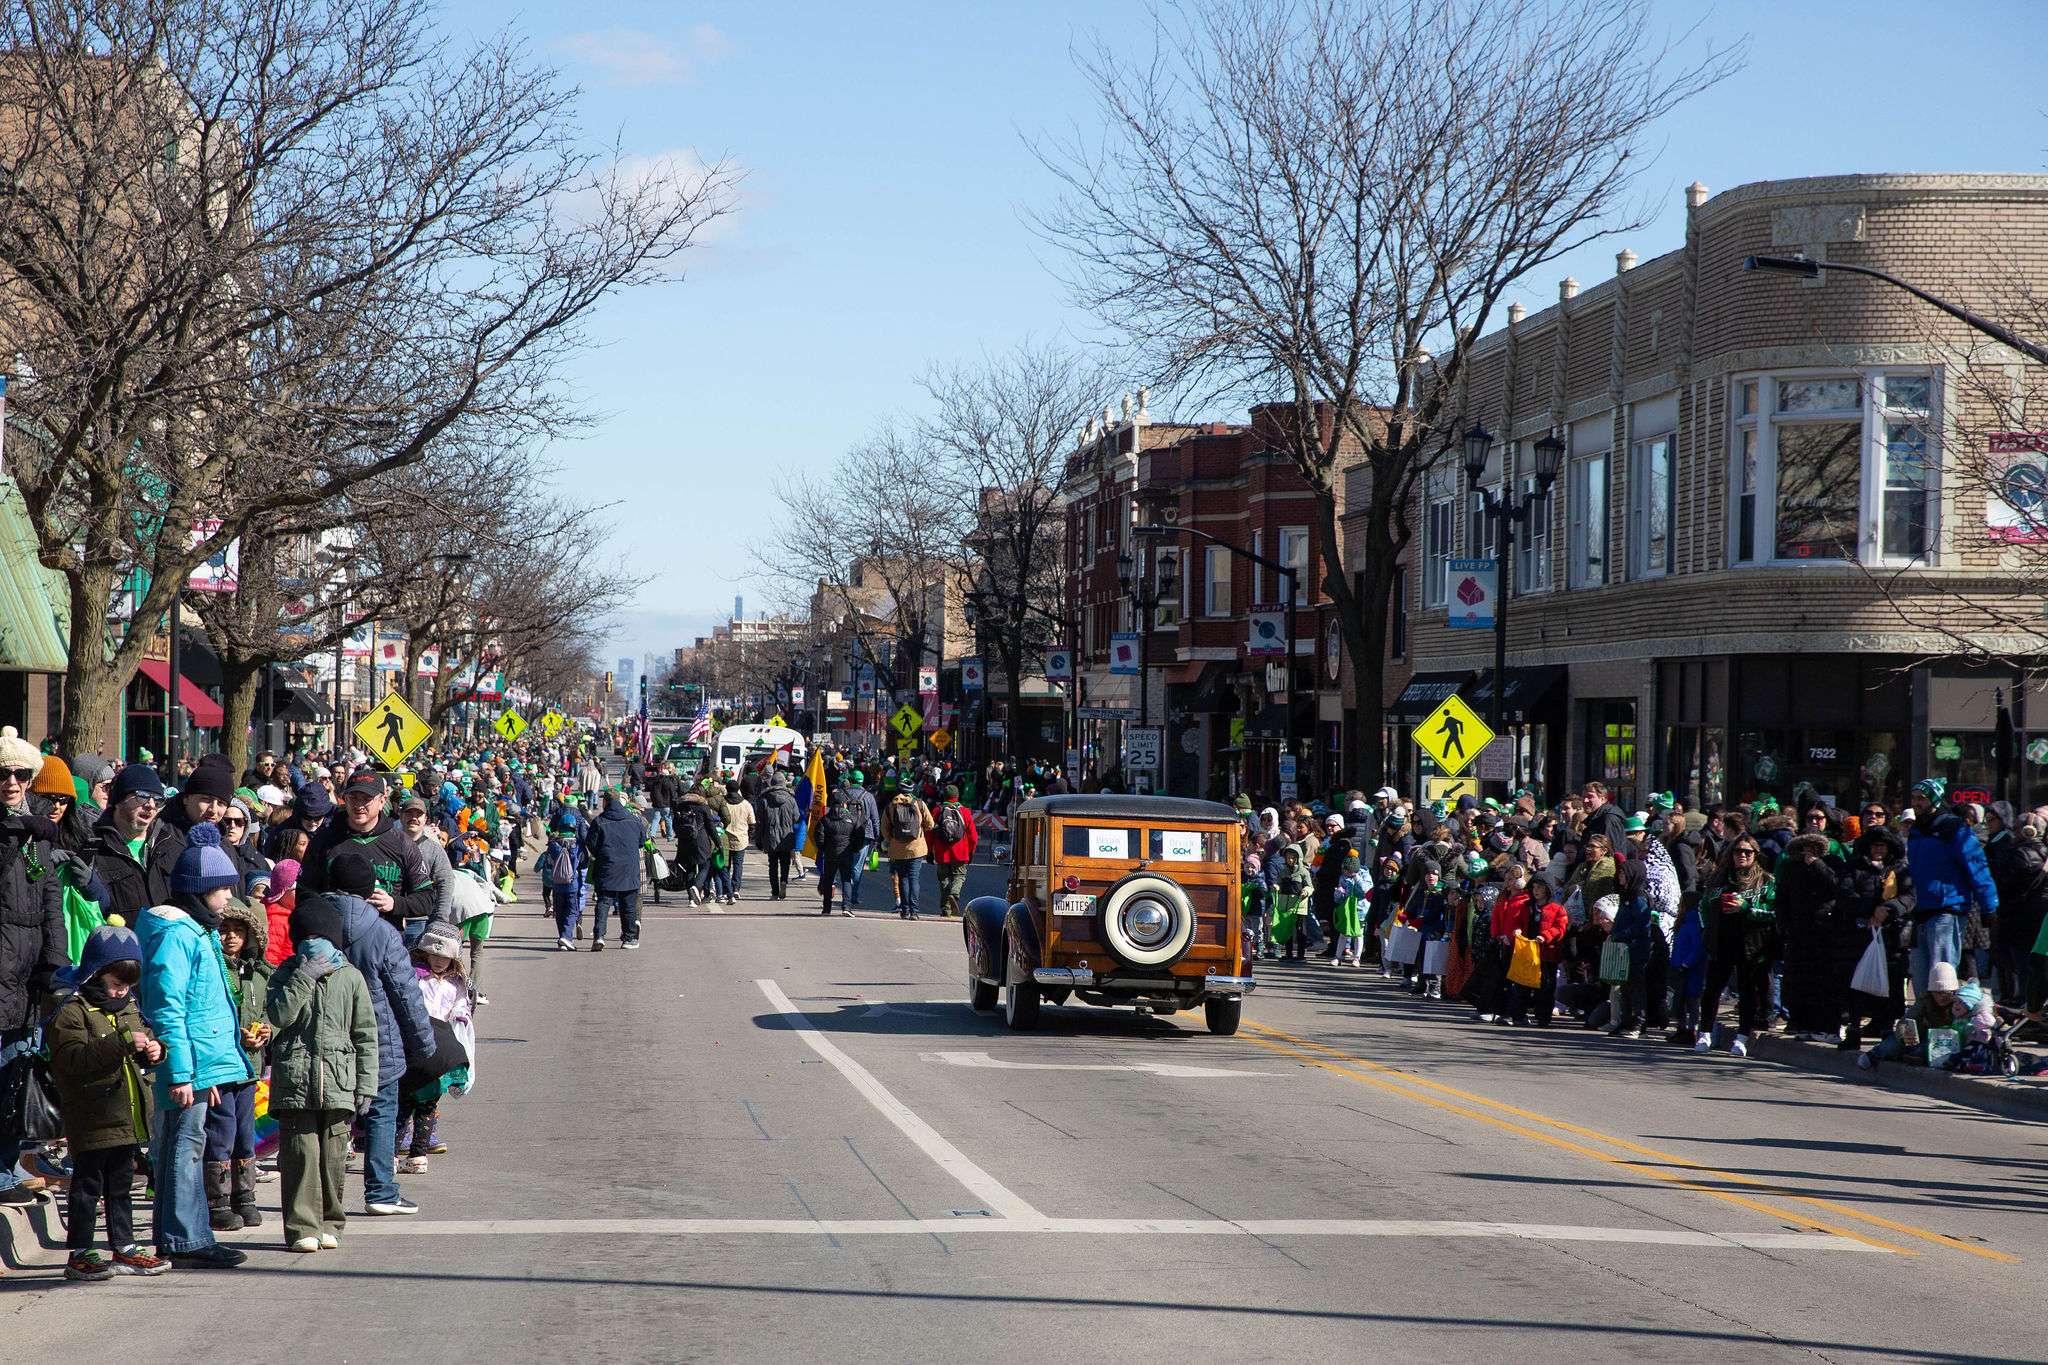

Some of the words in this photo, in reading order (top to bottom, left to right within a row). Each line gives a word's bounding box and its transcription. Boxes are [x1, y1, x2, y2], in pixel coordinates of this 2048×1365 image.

[1128, 733, 1157, 741] SPEED
[1129, 750, 1156, 765] 25
[1809, 747, 1836, 759] 7522
[1952, 790, 1991, 805] OPEN
[1099, 845, 1118, 853] GCM
[1172, 847, 1191, 855] GCM
[1056, 900, 1090, 912] NOMITES
